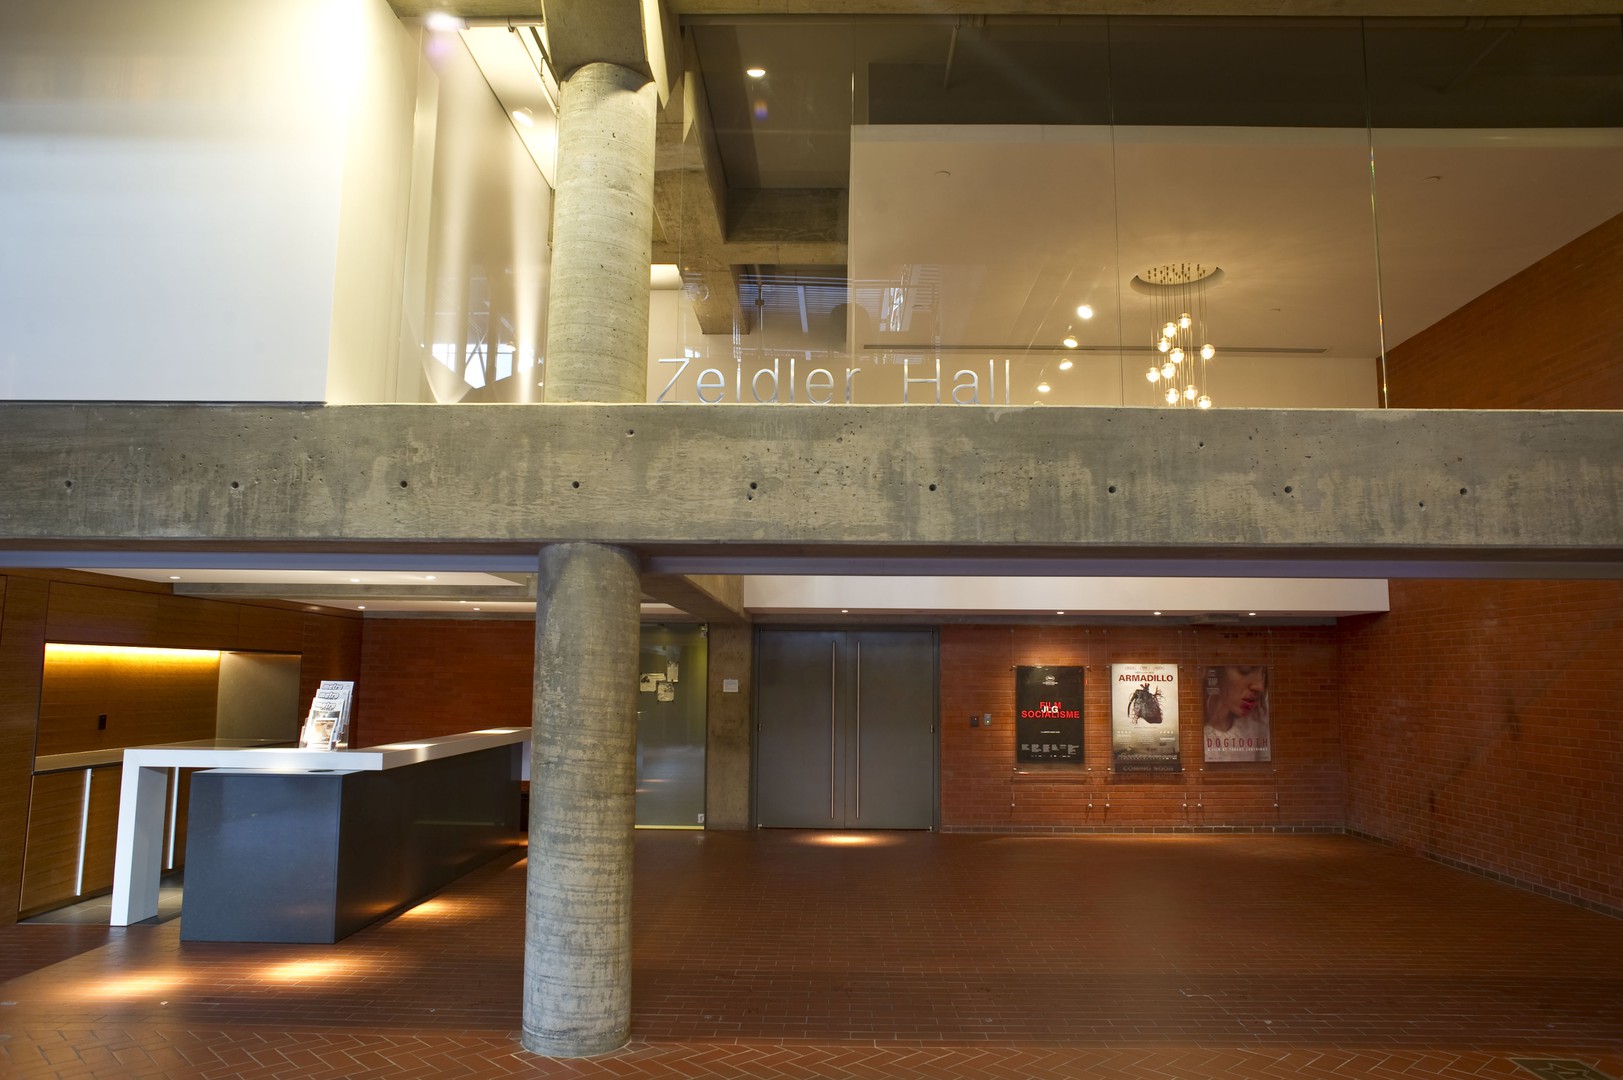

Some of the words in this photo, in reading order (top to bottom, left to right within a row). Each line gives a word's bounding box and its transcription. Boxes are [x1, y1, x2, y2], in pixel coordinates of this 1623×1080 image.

[656, 358, 861, 404] Zeidler
[903, 358, 1010, 404] Hall
[1118, 674, 1174, 682] ARMADILLO
[1041, 705, 1059, 713] JLG
[1021, 710, 1080, 718] SOCIALISME
[1207, 737, 1268, 748] DOGTOOTH
